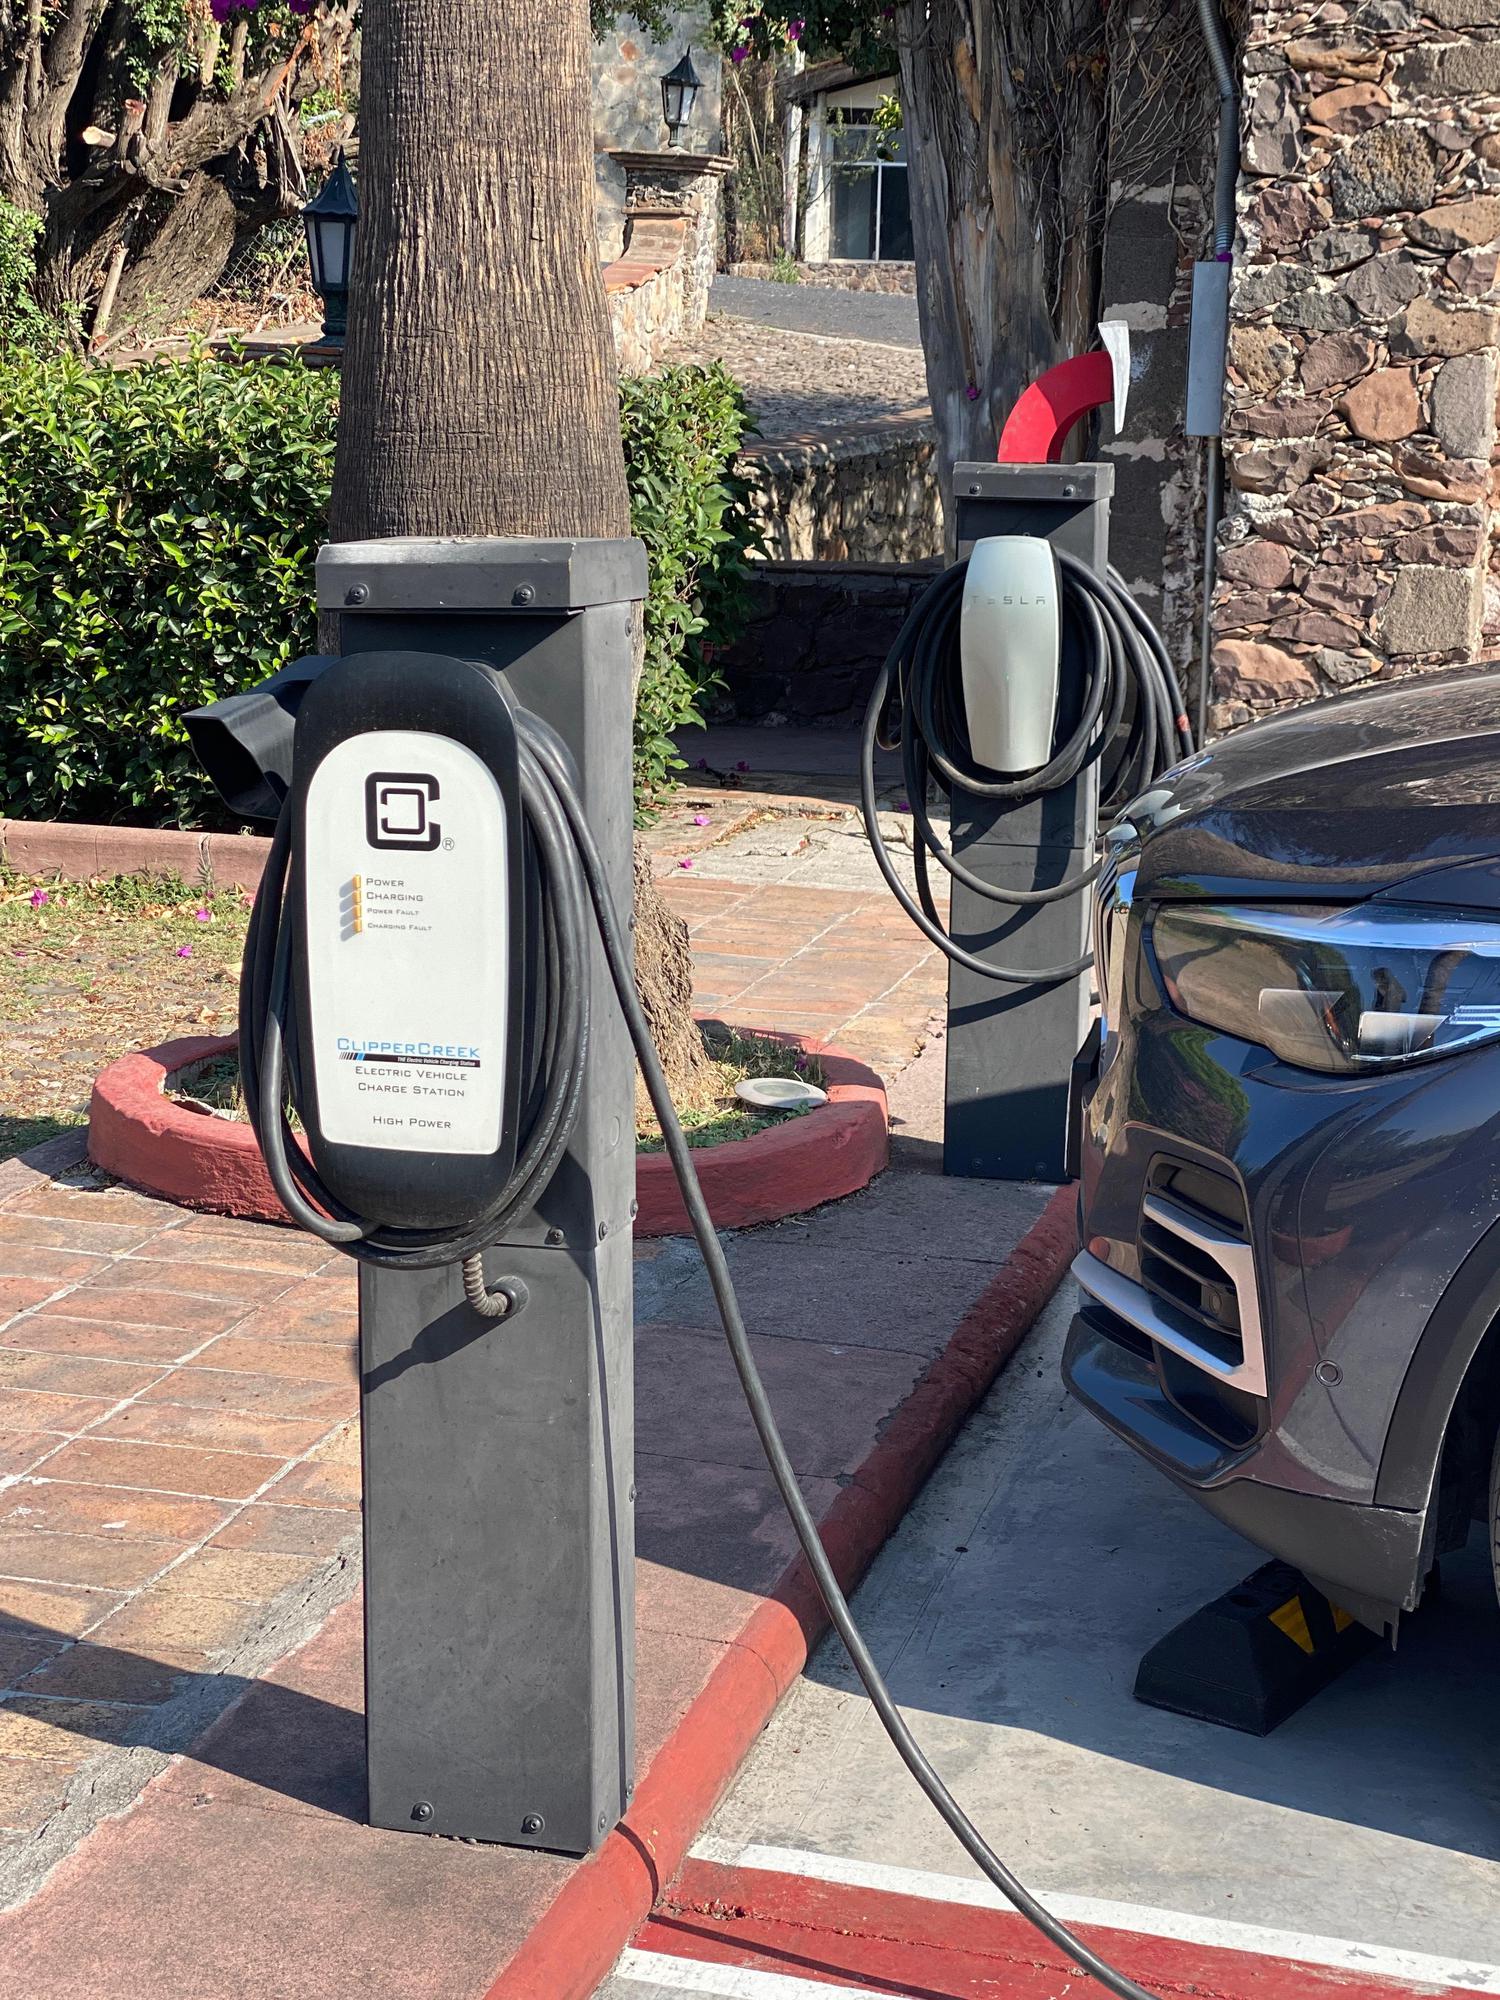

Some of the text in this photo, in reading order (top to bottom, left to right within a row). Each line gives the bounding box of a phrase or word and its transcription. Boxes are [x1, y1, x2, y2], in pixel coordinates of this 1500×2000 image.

[366, 877, 405, 888] POWER
[366, 891, 424, 902] CHARGING
[367, 907, 420, 916] POWER FAULT
[367, 922, 406, 930] CHARGING
[355, 1066, 468, 1081] ELECTRIC VEHICLE
[358, 1082, 465, 1097] CHARGE STATION
[372, 1115, 451, 1129] HIGH POWER
